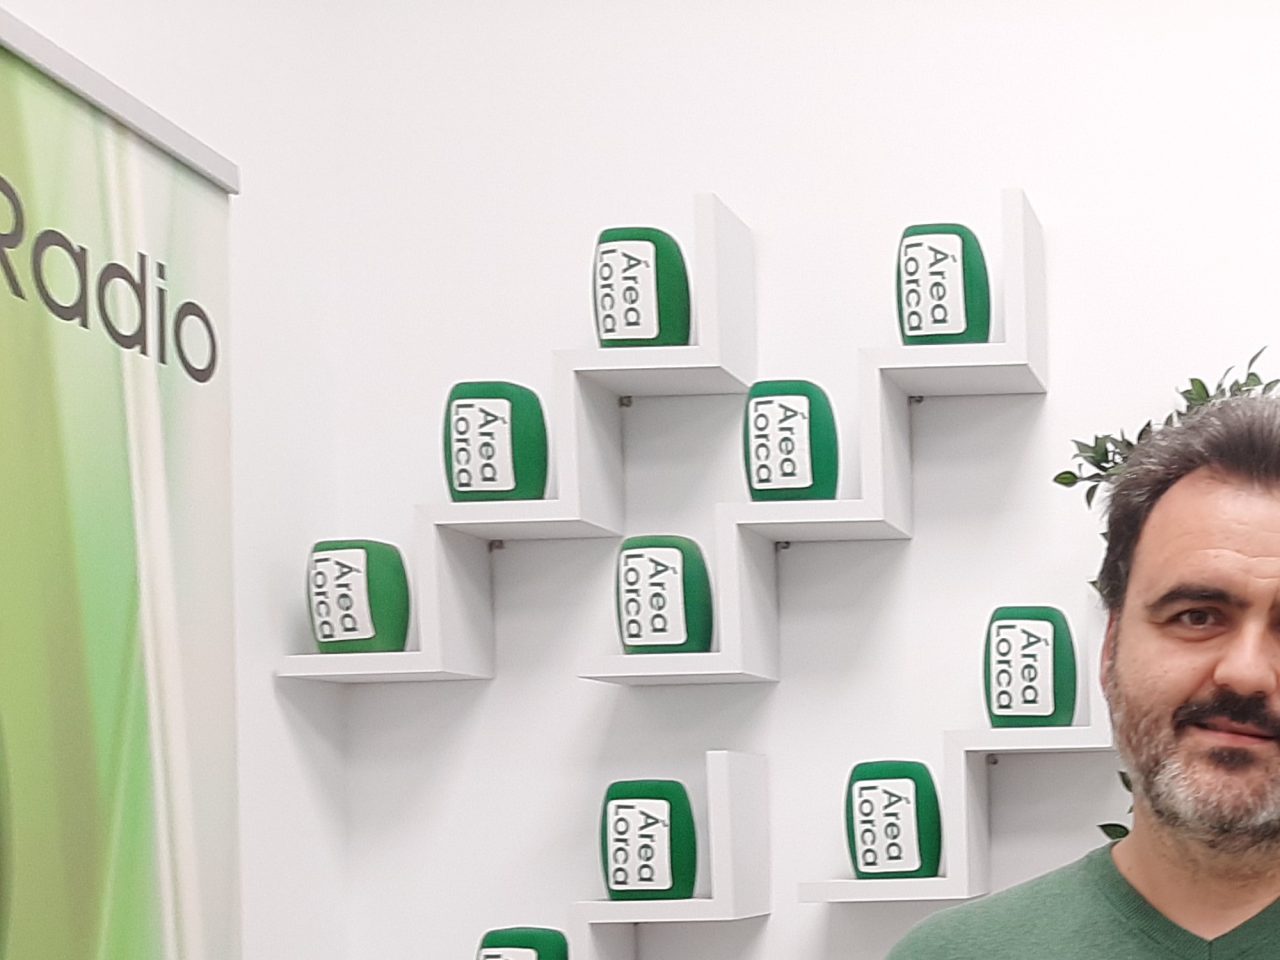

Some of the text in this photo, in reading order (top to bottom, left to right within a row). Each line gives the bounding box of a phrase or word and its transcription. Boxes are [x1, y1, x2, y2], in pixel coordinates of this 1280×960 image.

[0, 175, 217, 384] Radio
[600, 248, 617, 334] Lorca
[621, 252, 649, 326] Área
[904, 242, 923, 333] Lorca
[927, 245, 957, 326] Área
[454, 403, 474, 489] Lorca
[478, 407, 507, 484] Área
[753, 400, 773, 485] Lorca
[777, 404, 807, 479] Área
[312, 557, 334, 640] Lorca
[333, 559, 362, 634] Área
[624, 553, 644, 640] Lorca
[647, 558, 677, 633] Área
[996, 625, 1015, 710] Lorca
[1020, 629, 1049, 704] Área
[613, 804, 635, 886] Lorca
[637, 810, 668, 883] Área
[857, 785, 879, 868] Lorca
[882, 788, 911, 862] Área
